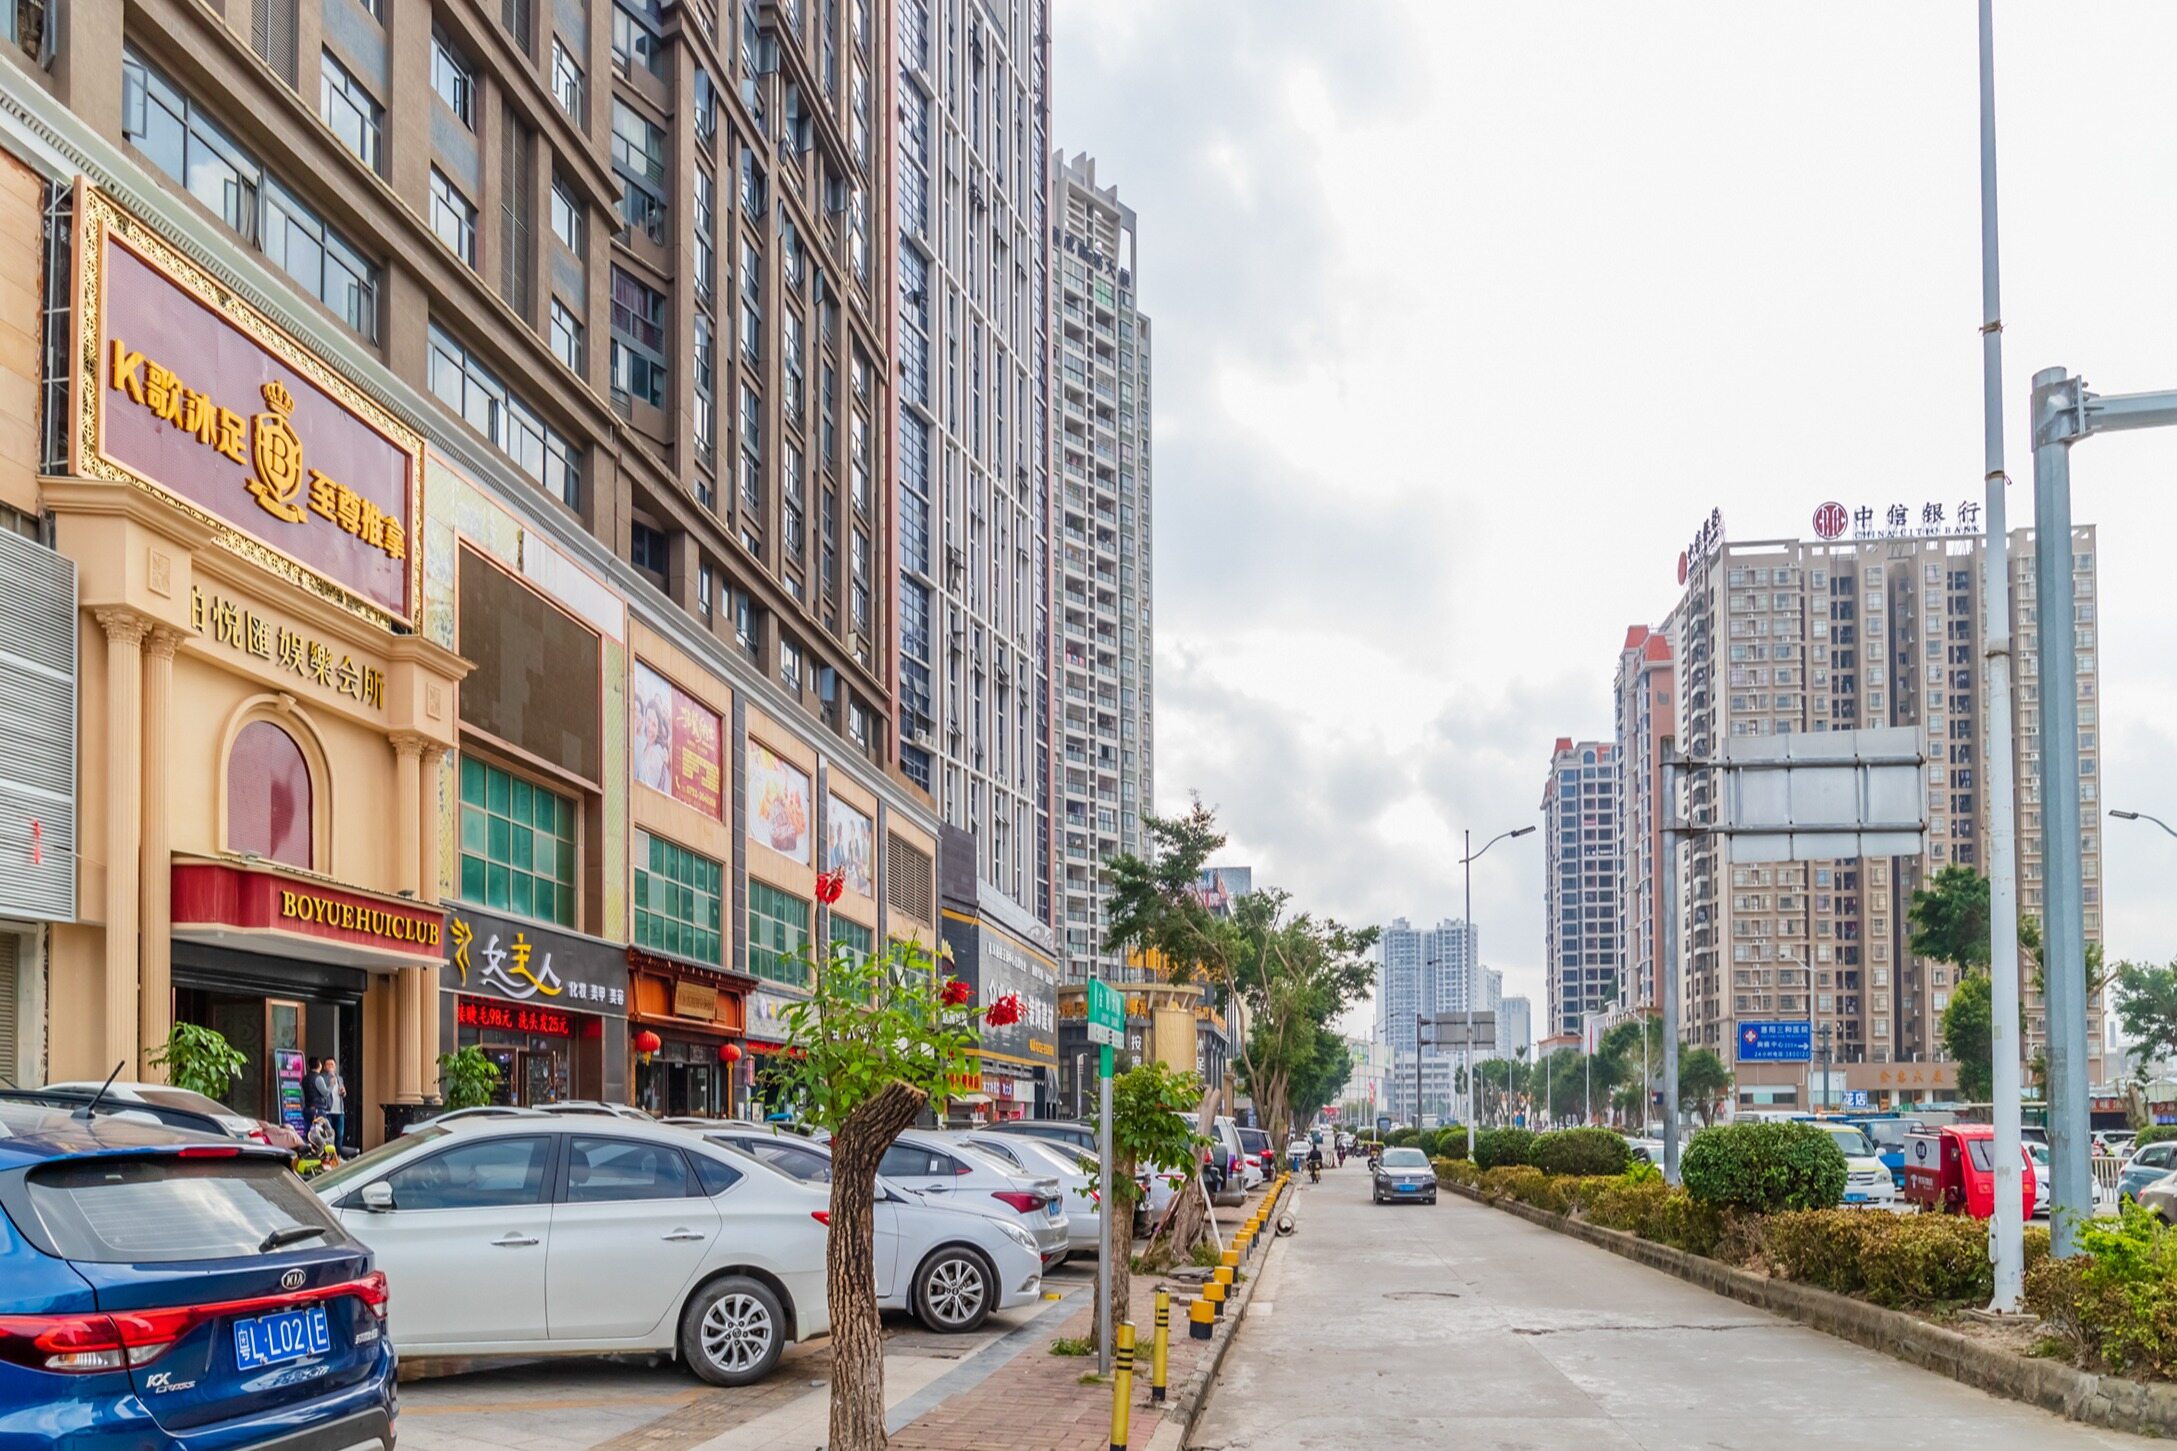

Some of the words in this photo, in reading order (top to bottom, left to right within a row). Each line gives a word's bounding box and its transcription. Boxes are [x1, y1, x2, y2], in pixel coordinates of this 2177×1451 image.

[110, 339, 247, 466] K歌沐足
[307, 468, 406, 560] 至尊推拿
[1854, 500, 1981, 529] 中信银行
[1945, 526, 1980, 534] BANK
[281, 890, 439, 945] BOYUEHUICLUB
[285, 1272, 305, 1287] KIA
